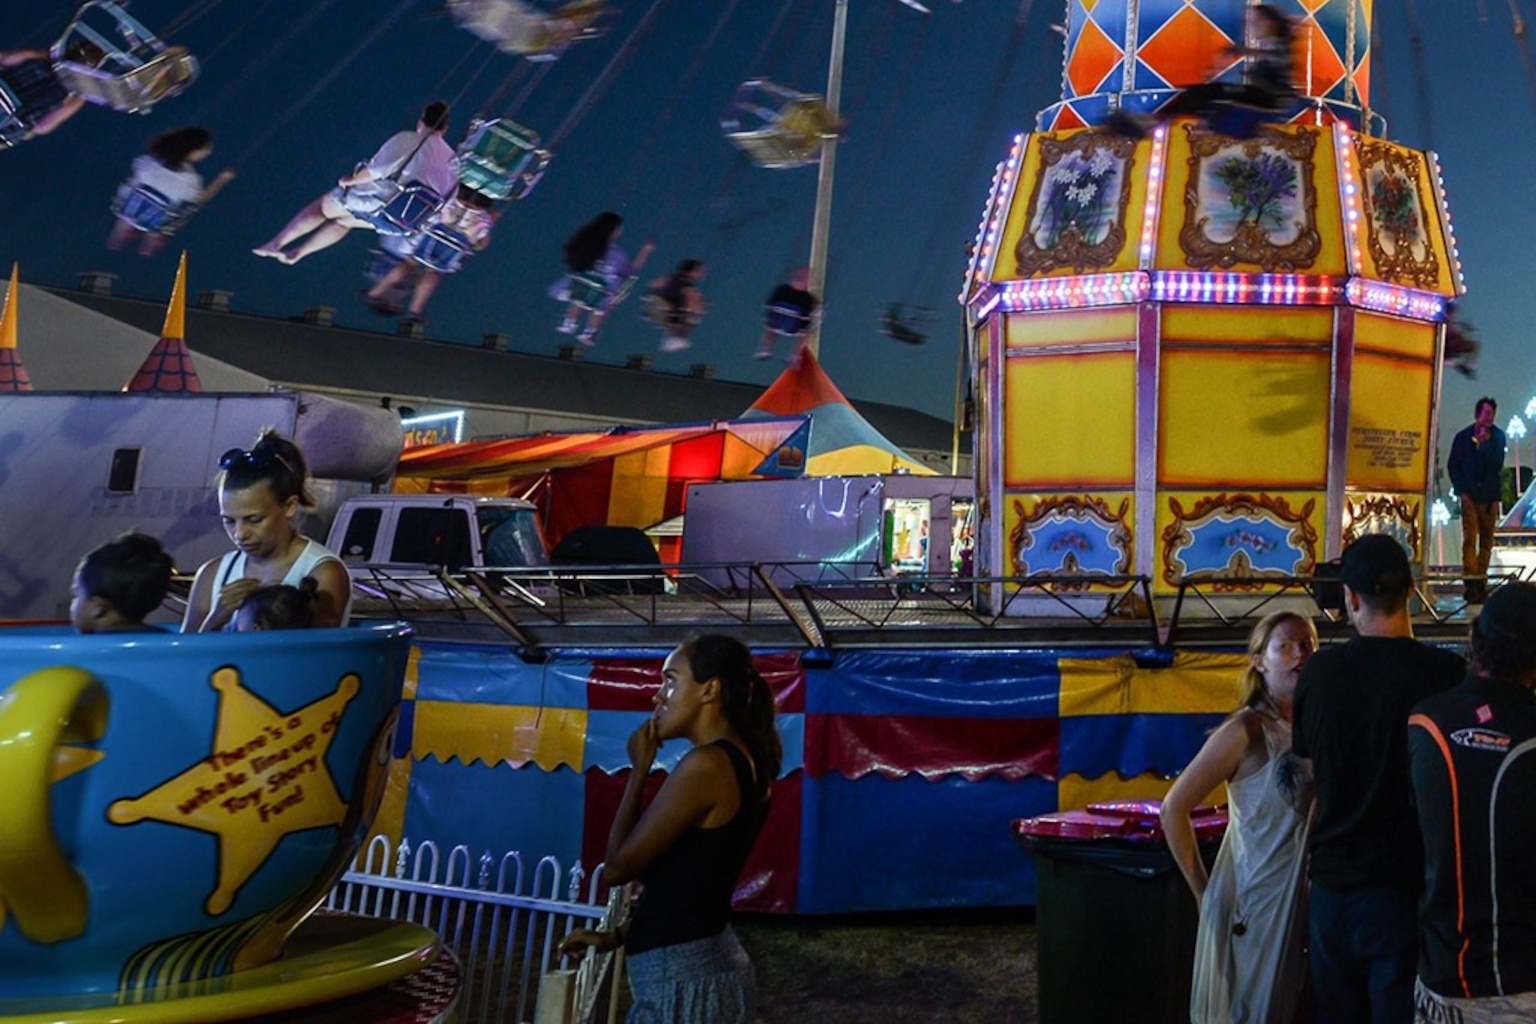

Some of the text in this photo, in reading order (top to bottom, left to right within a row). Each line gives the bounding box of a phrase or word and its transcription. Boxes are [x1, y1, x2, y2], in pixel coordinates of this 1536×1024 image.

[207, 716, 301, 771] There's a
[177, 773, 247, 814] whole
[220, 756, 317, 814] Toy Story
